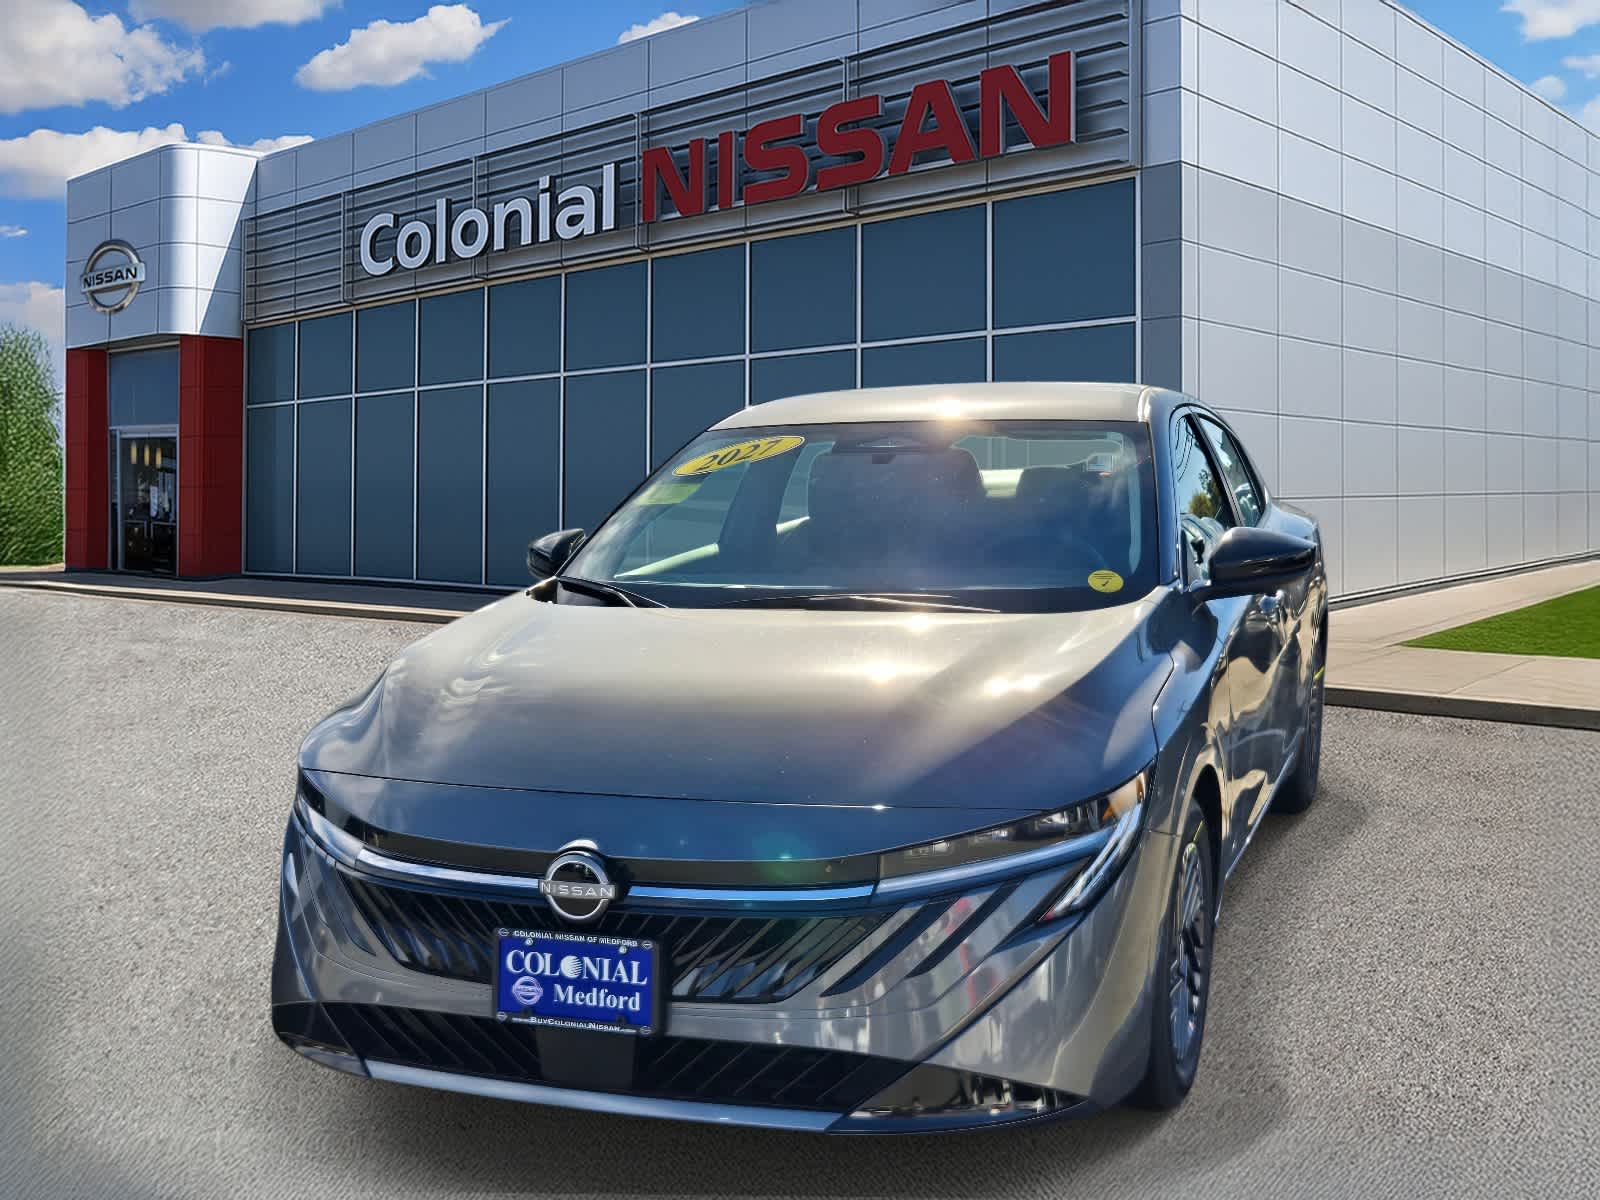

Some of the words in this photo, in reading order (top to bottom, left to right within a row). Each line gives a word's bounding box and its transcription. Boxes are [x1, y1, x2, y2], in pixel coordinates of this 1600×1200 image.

[360, 163, 616, 277] Colonial
[642, 51, 1075, 223] NISSAN
[83, 266, 138, 289] NISSAN
[694, 438, 785, 472] 2027
[541, 881, 613, 897] NISSAN
[514, 930, 553, 939] COLONIAL
[555, 933, 586, 942] NISSAN
[599, 937, 638, 947] MEDFORD
[506, 949, 648, 985] COLONIAL
[553, 983, 641, 1012] Medford
